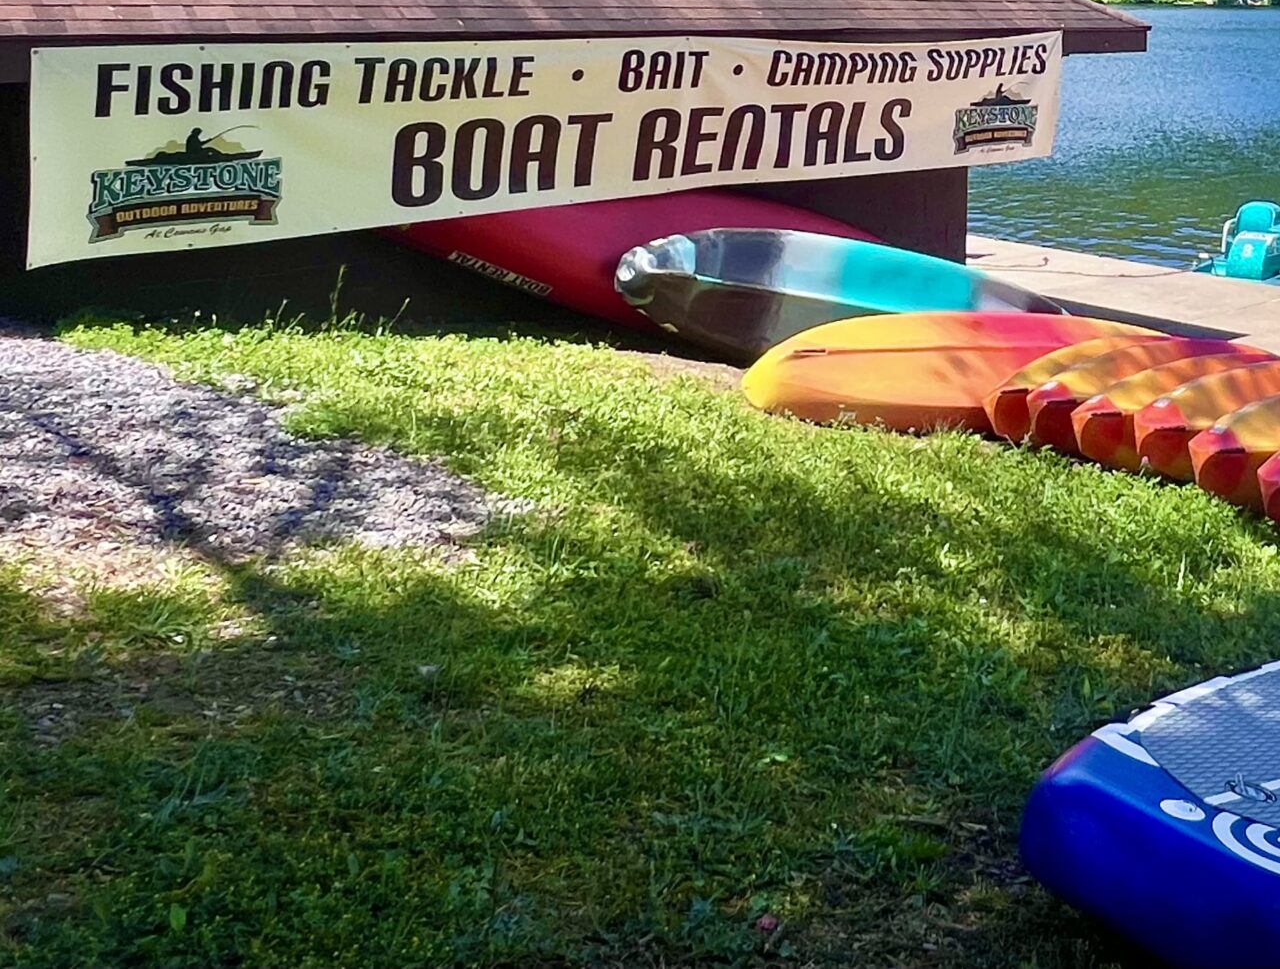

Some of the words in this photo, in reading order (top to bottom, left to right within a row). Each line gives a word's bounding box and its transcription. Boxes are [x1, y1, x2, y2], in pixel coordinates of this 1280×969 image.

[95, 60, 331, 117] FISHING
[354, 56, 535, 104] TACKLE
[618, 50, 710, 92] BAIT
[767, 50, 918, 86] CAMPING
[927, 43, 1048, 81] SUPPLIES
[956, 104, 1038, 131] KEYSTONE
[391, 113, 614, 208] BOAT
[632, 98, 912, 182] RENTALS
[91, 158, 282, 212] KEYSTONE
[116, 204, 177, 222] OUTDOOR
[181, 199, 259, 215] ADVENTURES
[453, 251, 510, 280] RENTAL
[511, 275, 550, 294] BOAT
